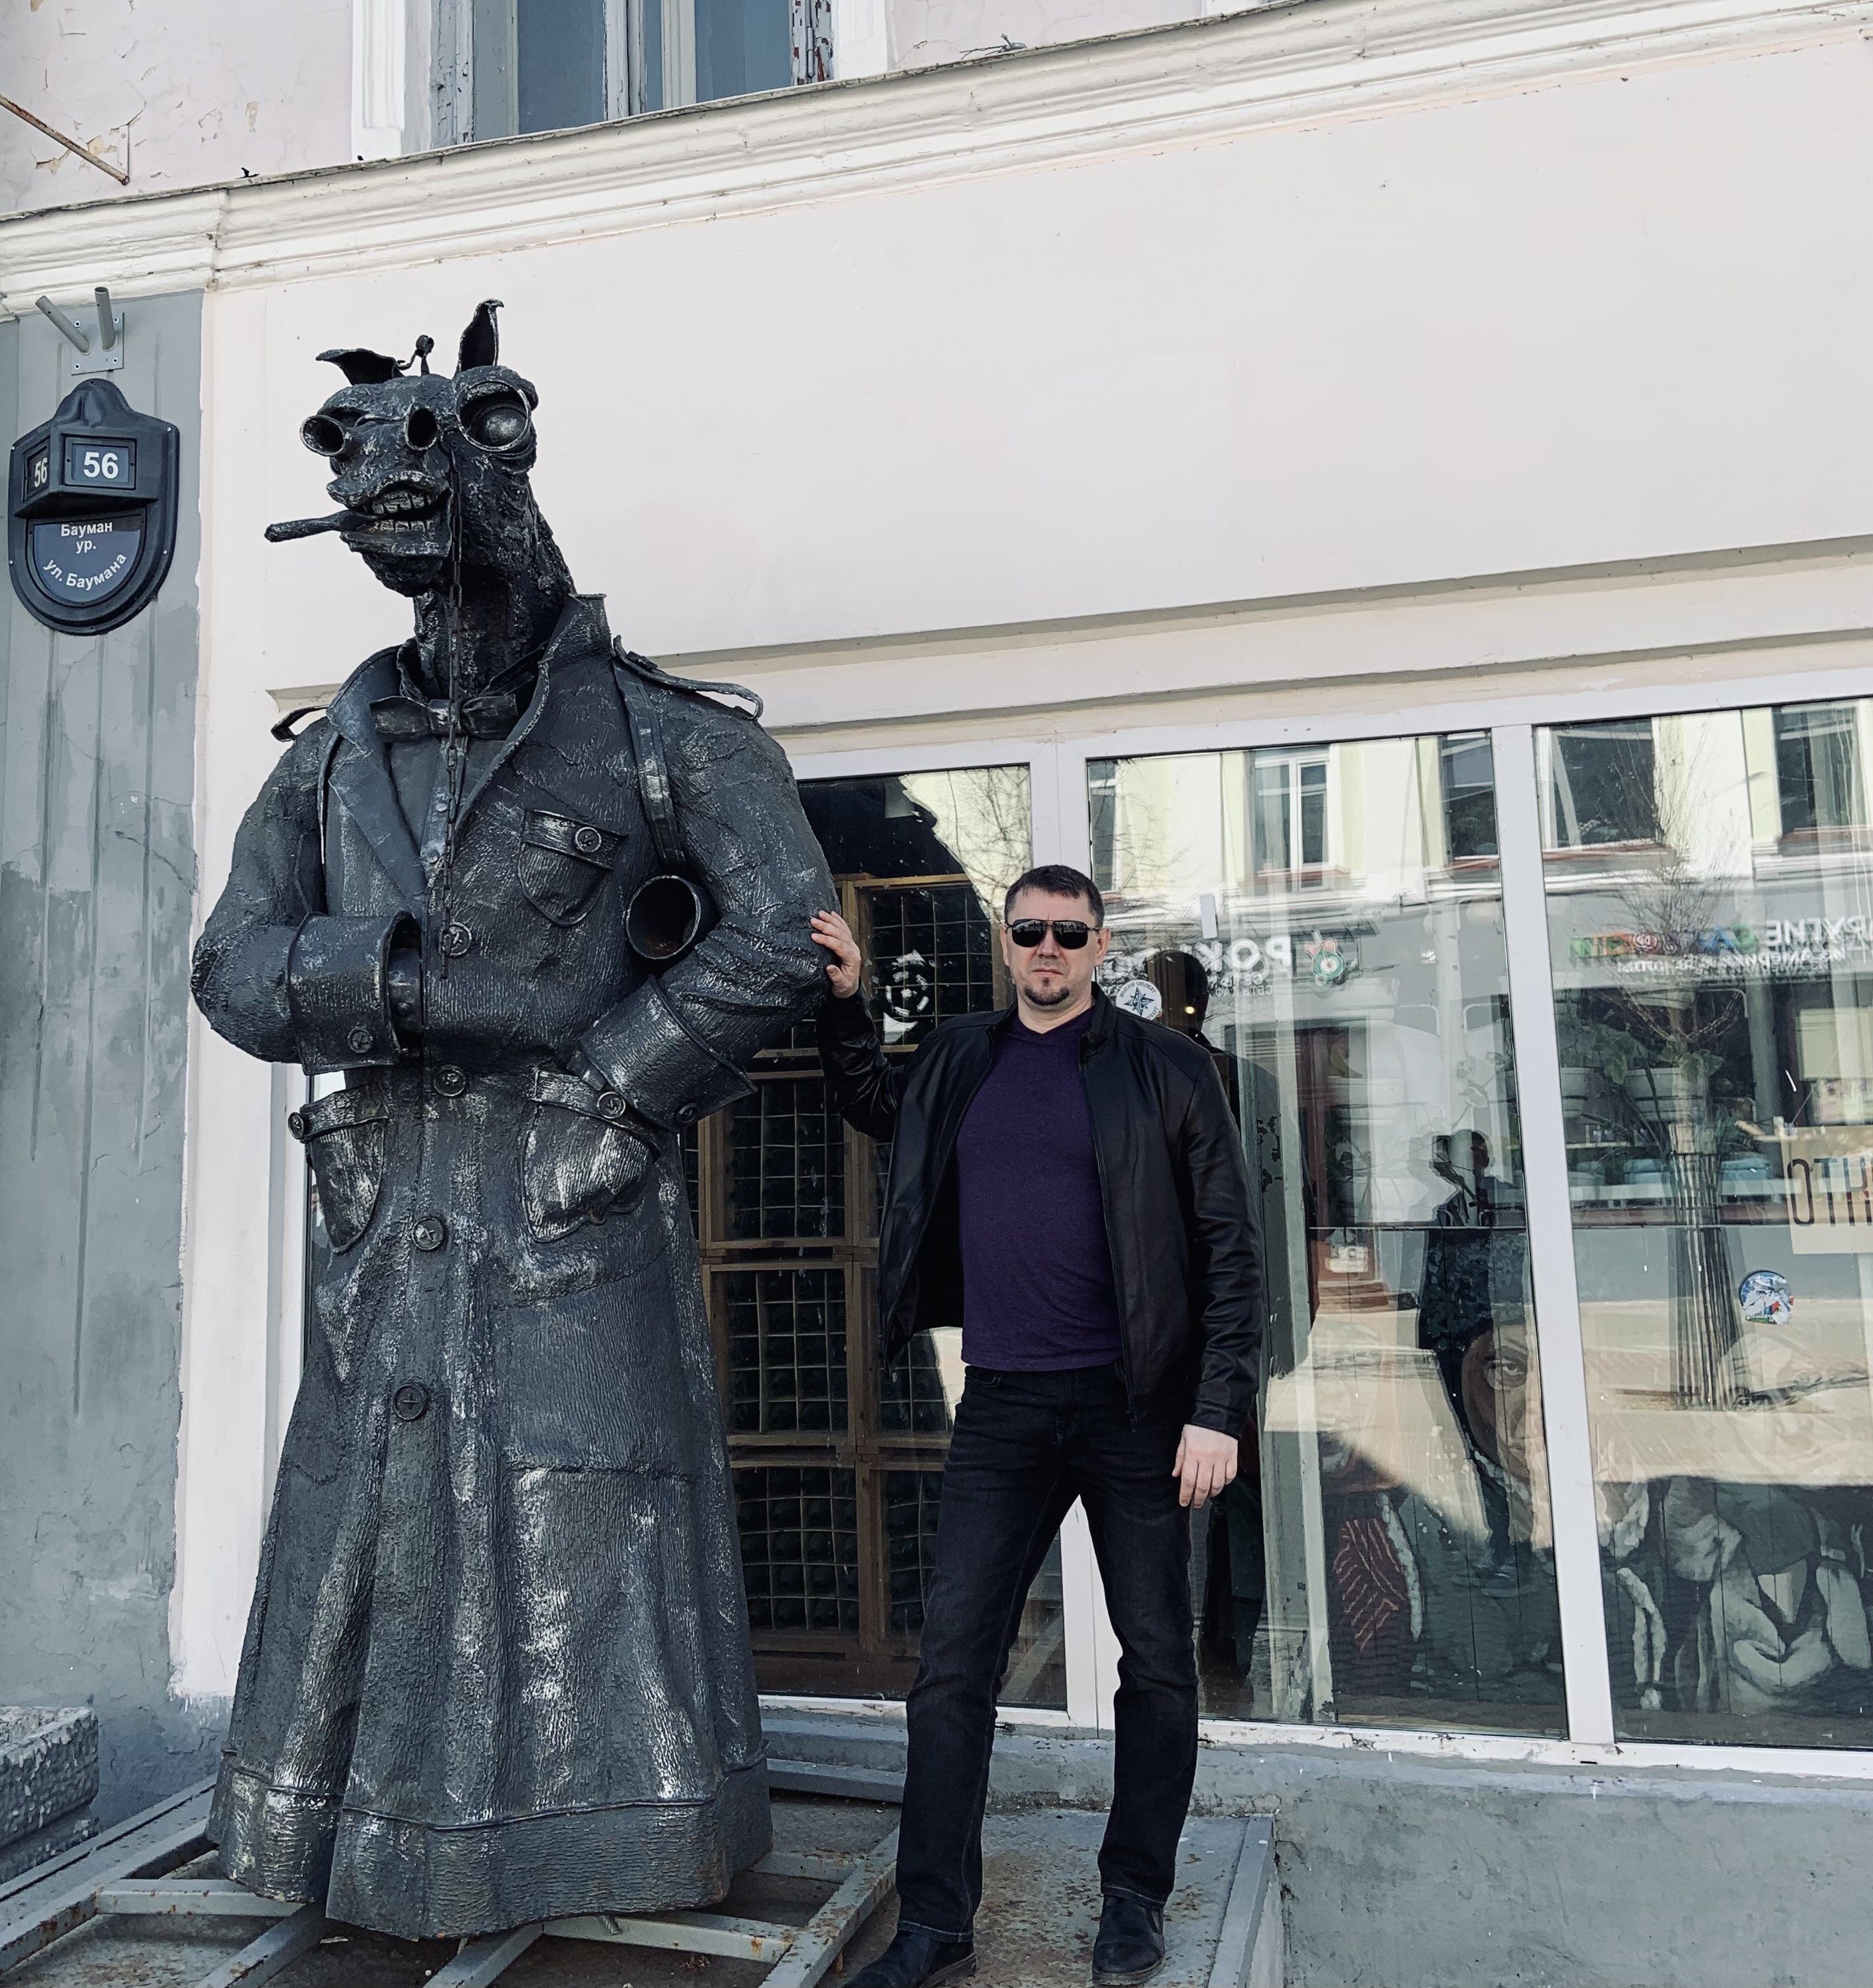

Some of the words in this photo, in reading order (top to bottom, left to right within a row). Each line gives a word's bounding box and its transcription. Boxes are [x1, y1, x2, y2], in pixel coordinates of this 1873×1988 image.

[34, 457, 48, 488] 56
[82, 451, 119, 479] 56
[61, 522, 112, 538] Бауман
[76, 539, 96, 554] ур.
[43, 559, 63, 582] ул.
[65, 554, 126, 591] Баумана
